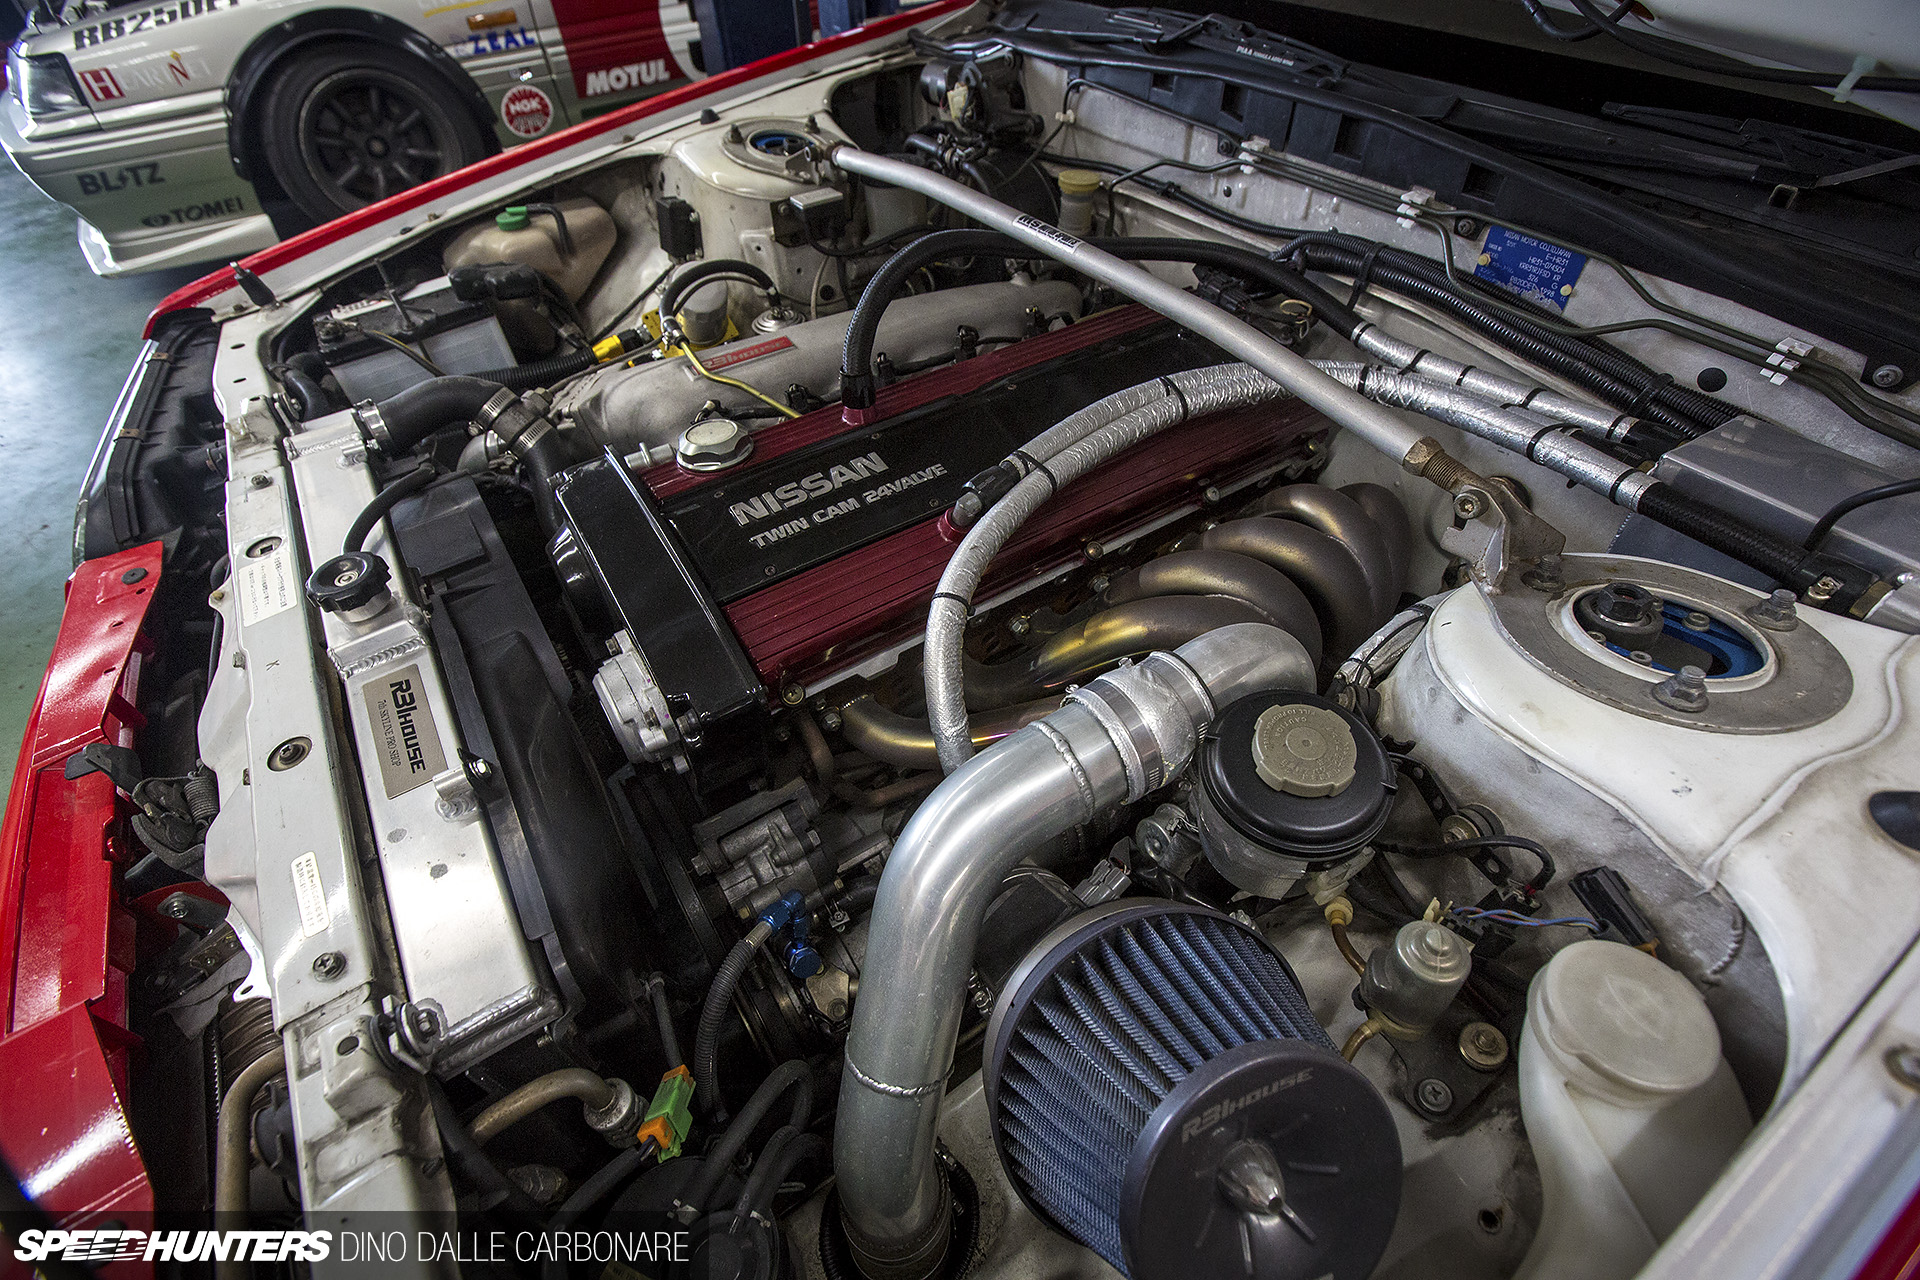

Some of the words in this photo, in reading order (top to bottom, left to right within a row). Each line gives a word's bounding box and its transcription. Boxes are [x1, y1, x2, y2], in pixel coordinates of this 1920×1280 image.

[468, 27, 535, 54] ZEAL
[586, 58, 671, 96] MOTUL
[76, 162, 165, 196] BLITZ
[170, 197, 244, 224] TOMEI
[730, 451, 889, 526] NISSAN
[749, 517, 810, 548] TWIN
[812, 497, 861, 525] CAM
[862, 463, 948, 504] 24VALVE
[1274, 716, 1307, 738] CAUTION
[386, 736, 396, 749] PRO
[389, 749, 401, 767] SHOP
